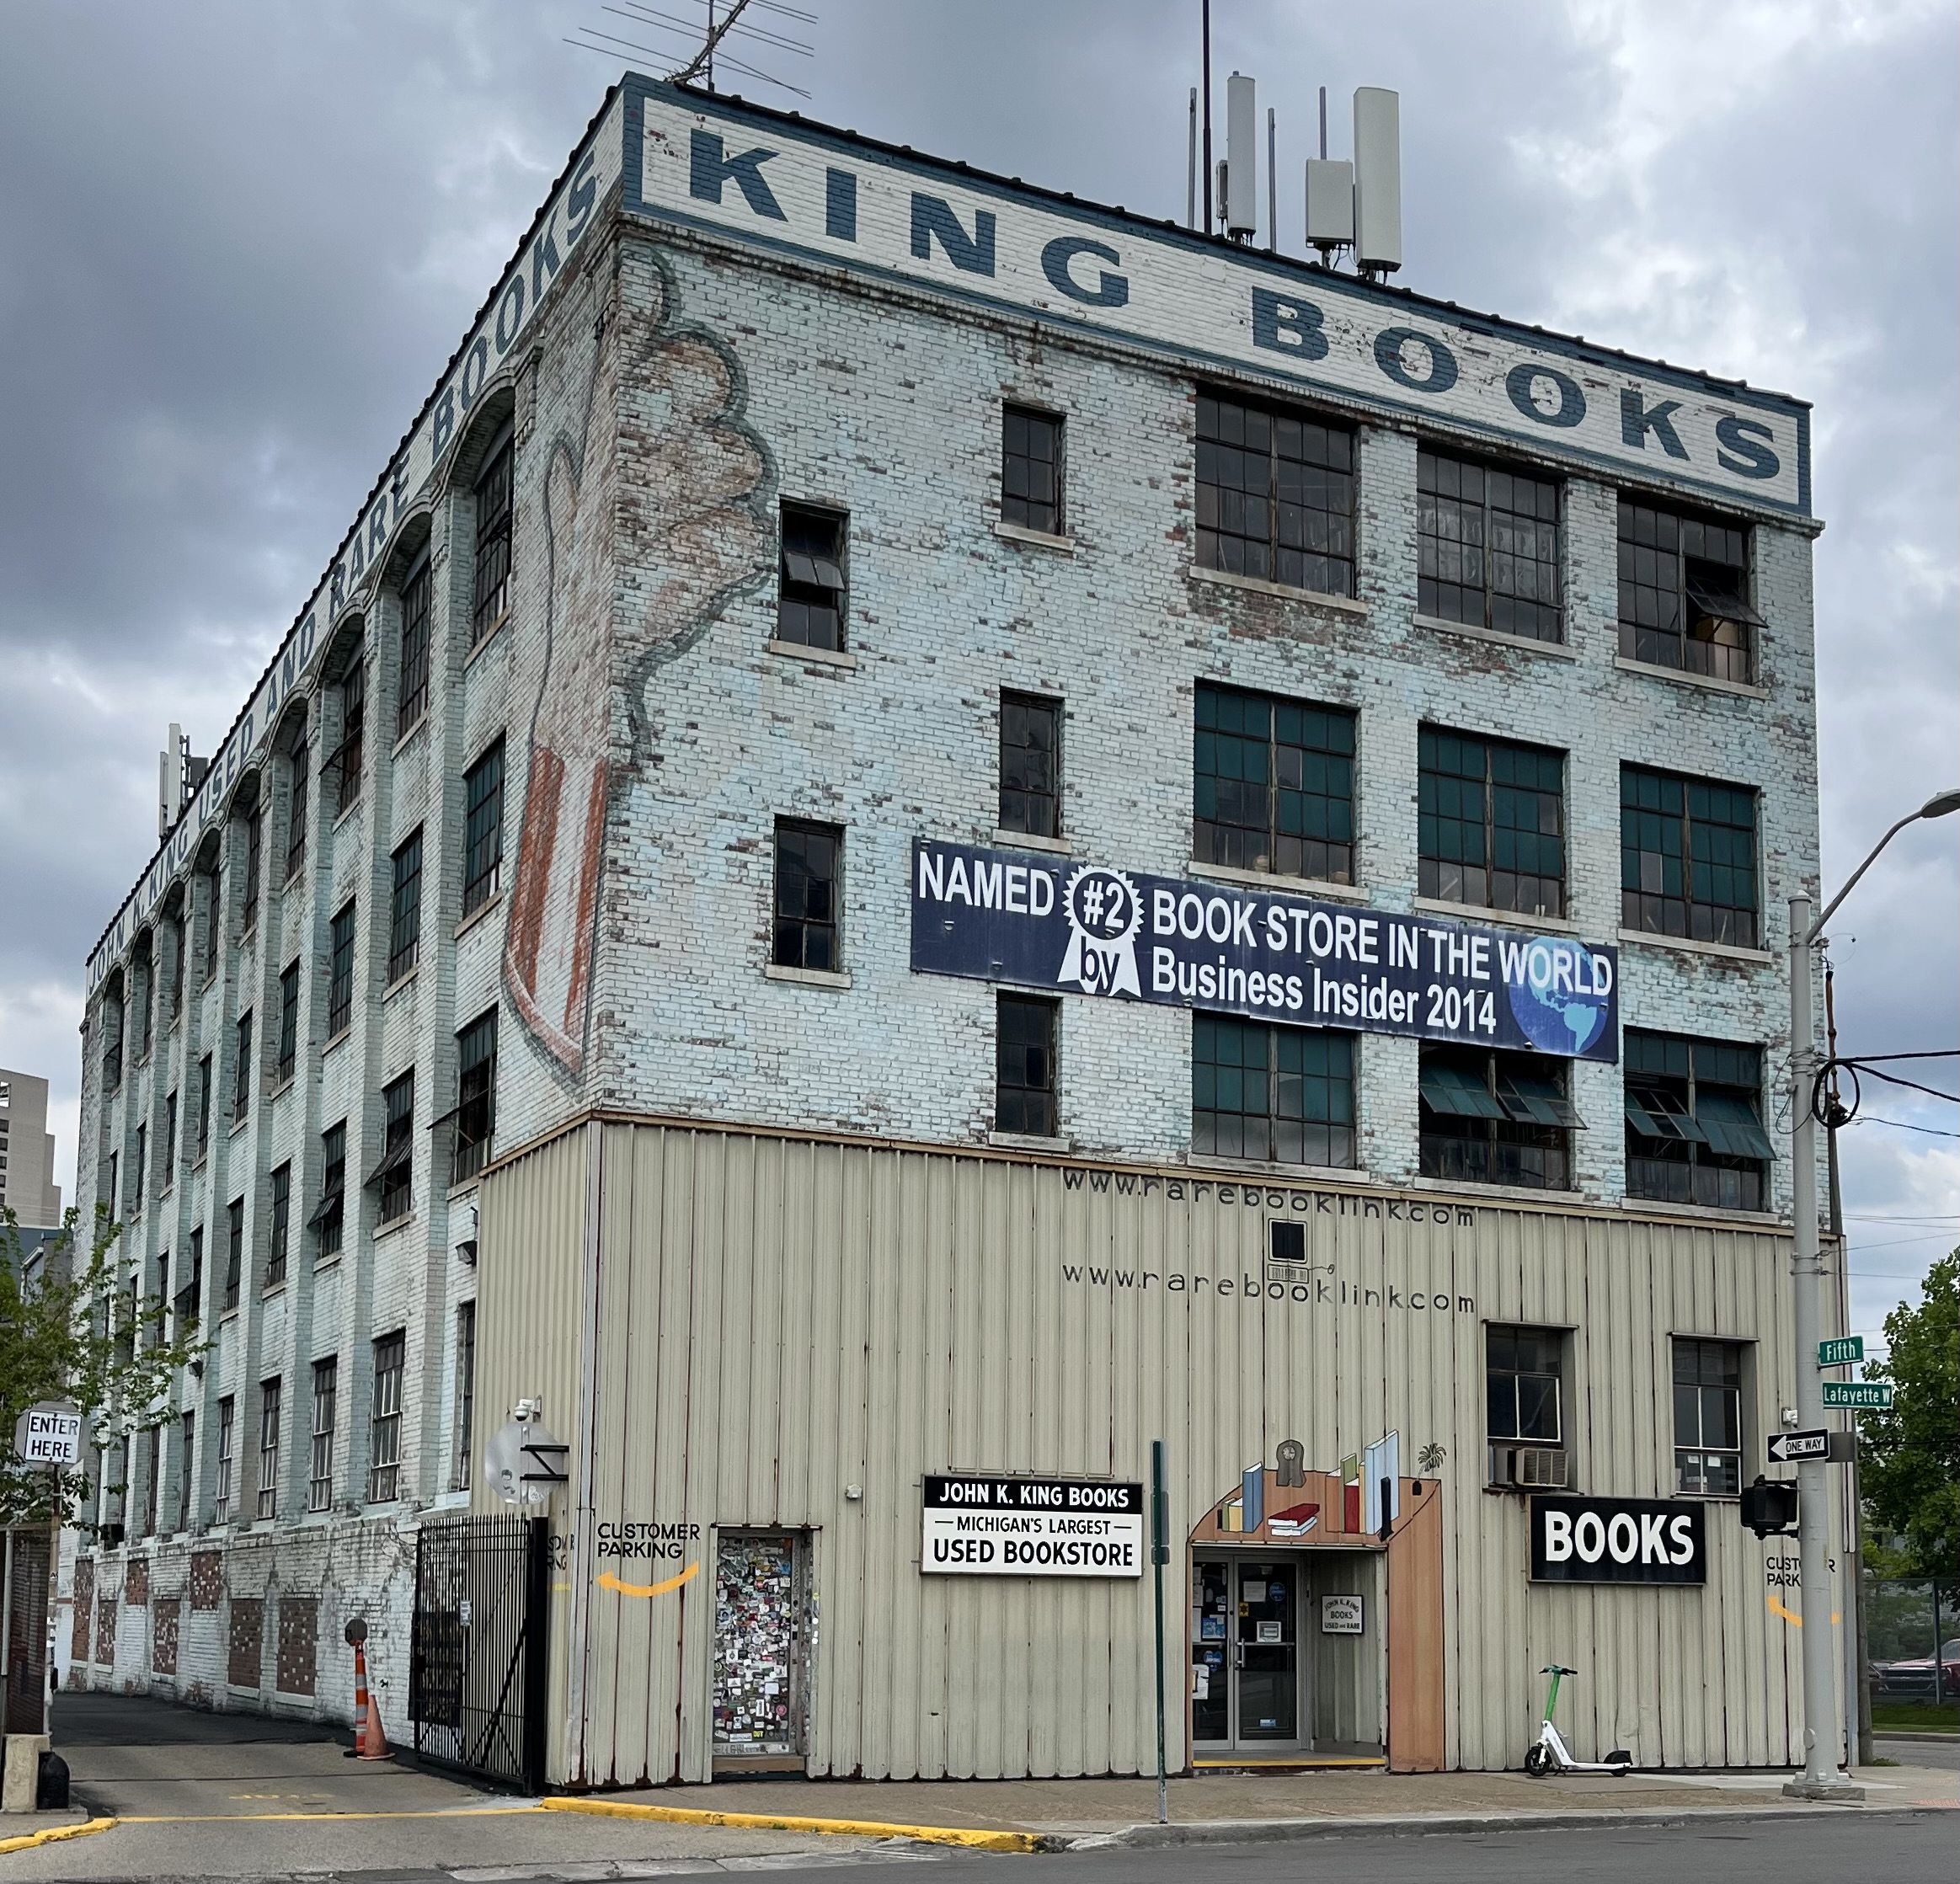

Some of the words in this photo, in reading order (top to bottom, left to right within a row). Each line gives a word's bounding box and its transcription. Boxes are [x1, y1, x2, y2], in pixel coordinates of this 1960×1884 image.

[690, 128, 1129, 307] KING
[1252, 286, 1780, 480] BOOKS
[88, 915, 126, 995] JOHN
[149, 819, 188, 895] KING
[199, 713, 252, 830] USED
[264, 611, 316, 727] AND
[328, 452, 412, 623] RARE
[432, 149, 596, 467] BOOKS
[918, 851, 1055, 916] NAMED
[1082, 881, 1125, 930] #2
[1153, 889, 1257, 948] BOOK
[1265, 905, 1379, 965] STORE
[1388, 927, 1419, 969] IN
[1427, 929, 1490, 980] THE
[1498, 942, 1613, 996] WORLD
[1081, 942, 1120, 995] by
[1153, 946, 1303, 1011] Business
[1314, 978, 1419, 1025] Insider
[1426, 984, 1497, 1035] 2014
[1062, 1264, 1474, 1313] www.rarebooklink.com
[1826, 1342, 1856, 1361] Fifth
[1824, 1387, 1879, 1404] Lafayette
[1883, 1389, 1890, 1403] W
[30, 1416, 78, 1436] ENTER
[31, 1439, 72, 1458] HERE
[1786, 1442, 1802, 1452] ONE
[1805, 1438, 1823, 1449] WAY
[940, 1483, 989, 1503] JOHN
[996, 1485, 1013, 1503] K.
[1021, 1486, 1063, 1506] KING
[1069, 1487, 1129, 1508] BOOKS
[597, 1523, 700, 1540] CUSTOMER
[957, 1516, 1042, 1533] MICHIGAN'S
[1049, 1518, 1111, 1534] LARGEST
[597, 1542, 683, 1558] PARKING
[1545, 1511, 1694, 1565] BOOKS
[934, 1539, 995, 1562] USED
[1004, 1540, 1133, 1566] BOOKSTORE
[1766, 1556, 1835, 1572] CUSTR
[1331, 1610, 1354, 1619] BOOKS
